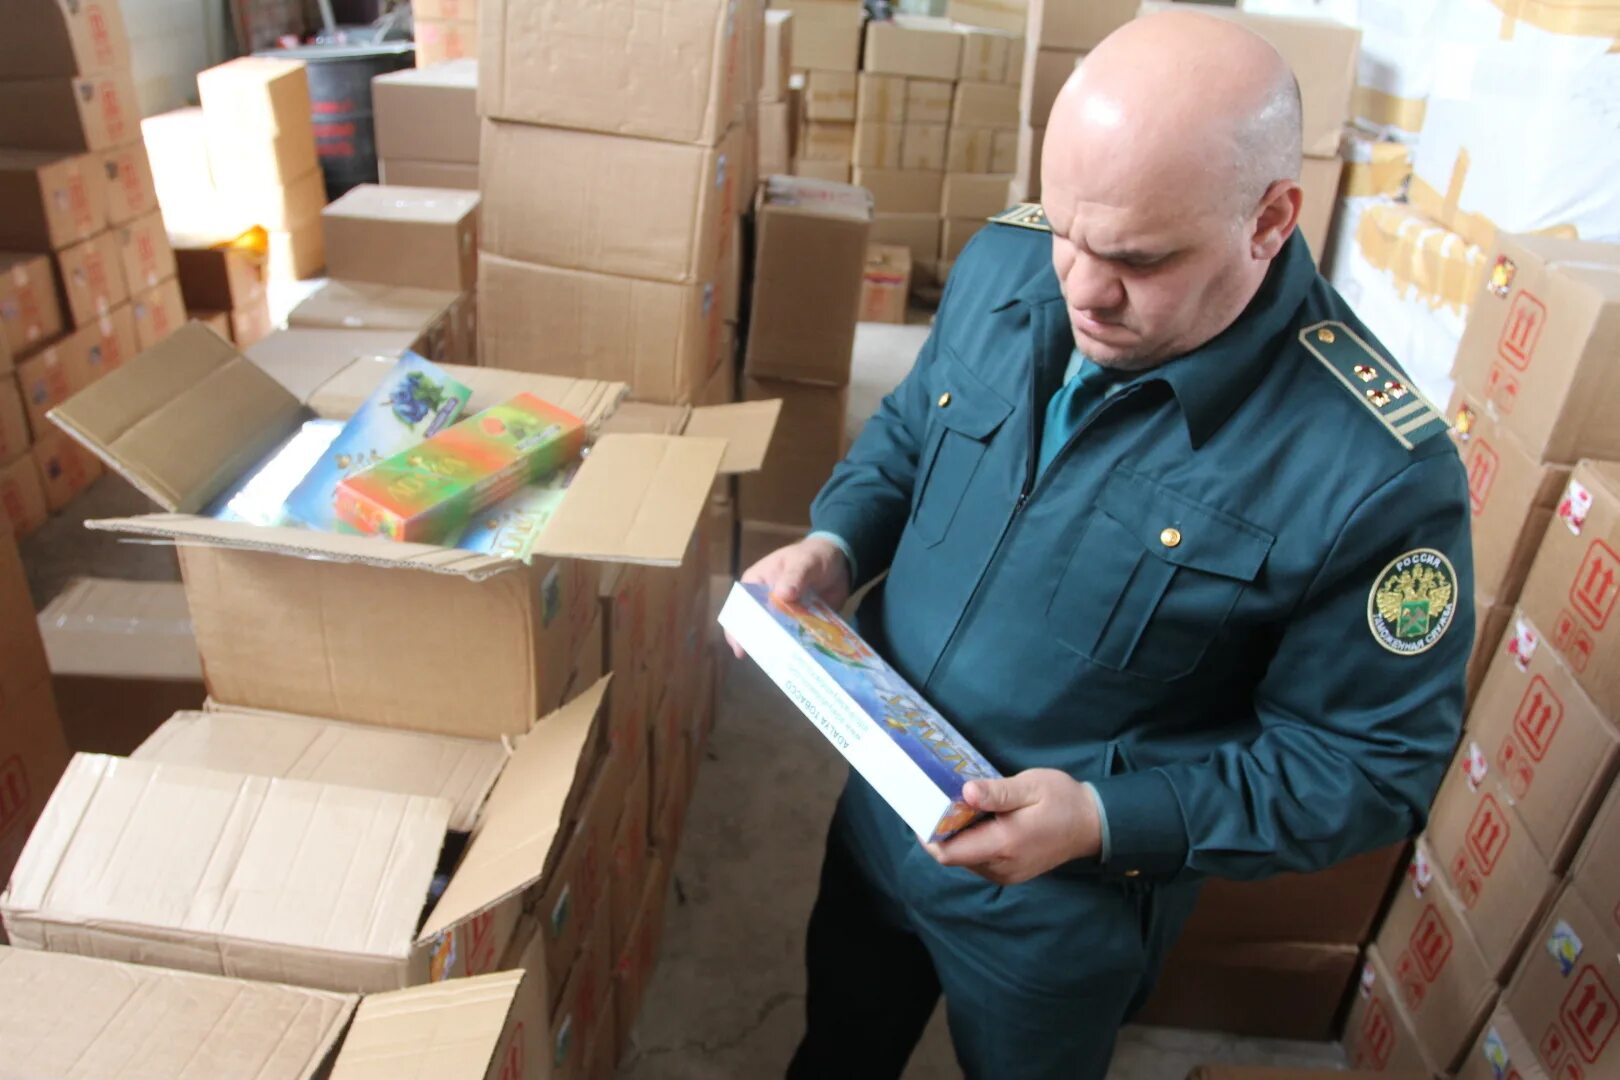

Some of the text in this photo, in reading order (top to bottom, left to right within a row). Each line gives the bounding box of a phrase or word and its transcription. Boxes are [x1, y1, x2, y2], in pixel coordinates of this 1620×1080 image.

[1396, 553, 1441, 571] РОССИЯ
[1373, 603, 1453, 651] ТАМОЖЕННАЯ СЛУЖБА
[783, 679, 822, 719] TOBACCO
[818, 716, 850, 749] ADALYA
